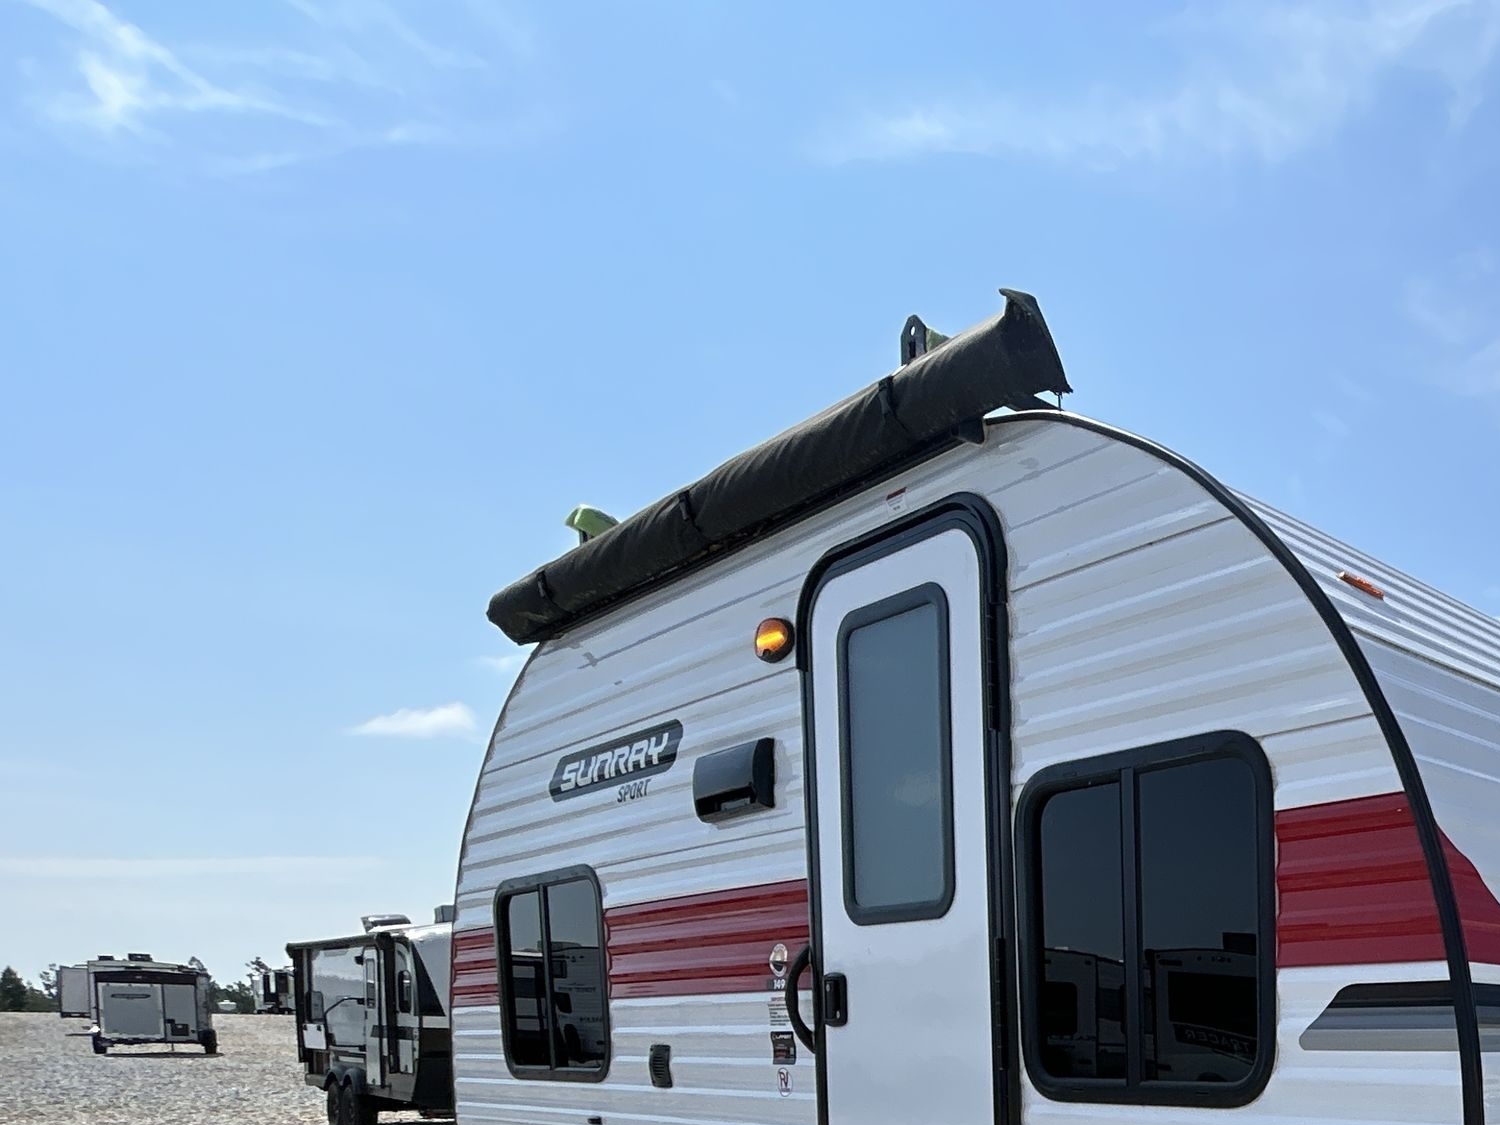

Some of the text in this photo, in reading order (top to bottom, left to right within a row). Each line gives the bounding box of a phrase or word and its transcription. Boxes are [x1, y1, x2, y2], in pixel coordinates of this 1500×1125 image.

[560, 732, 669, 792] SUNRAY
[617, 778, 652, 803] SPORT
[773, 978, 786, 990] 149
